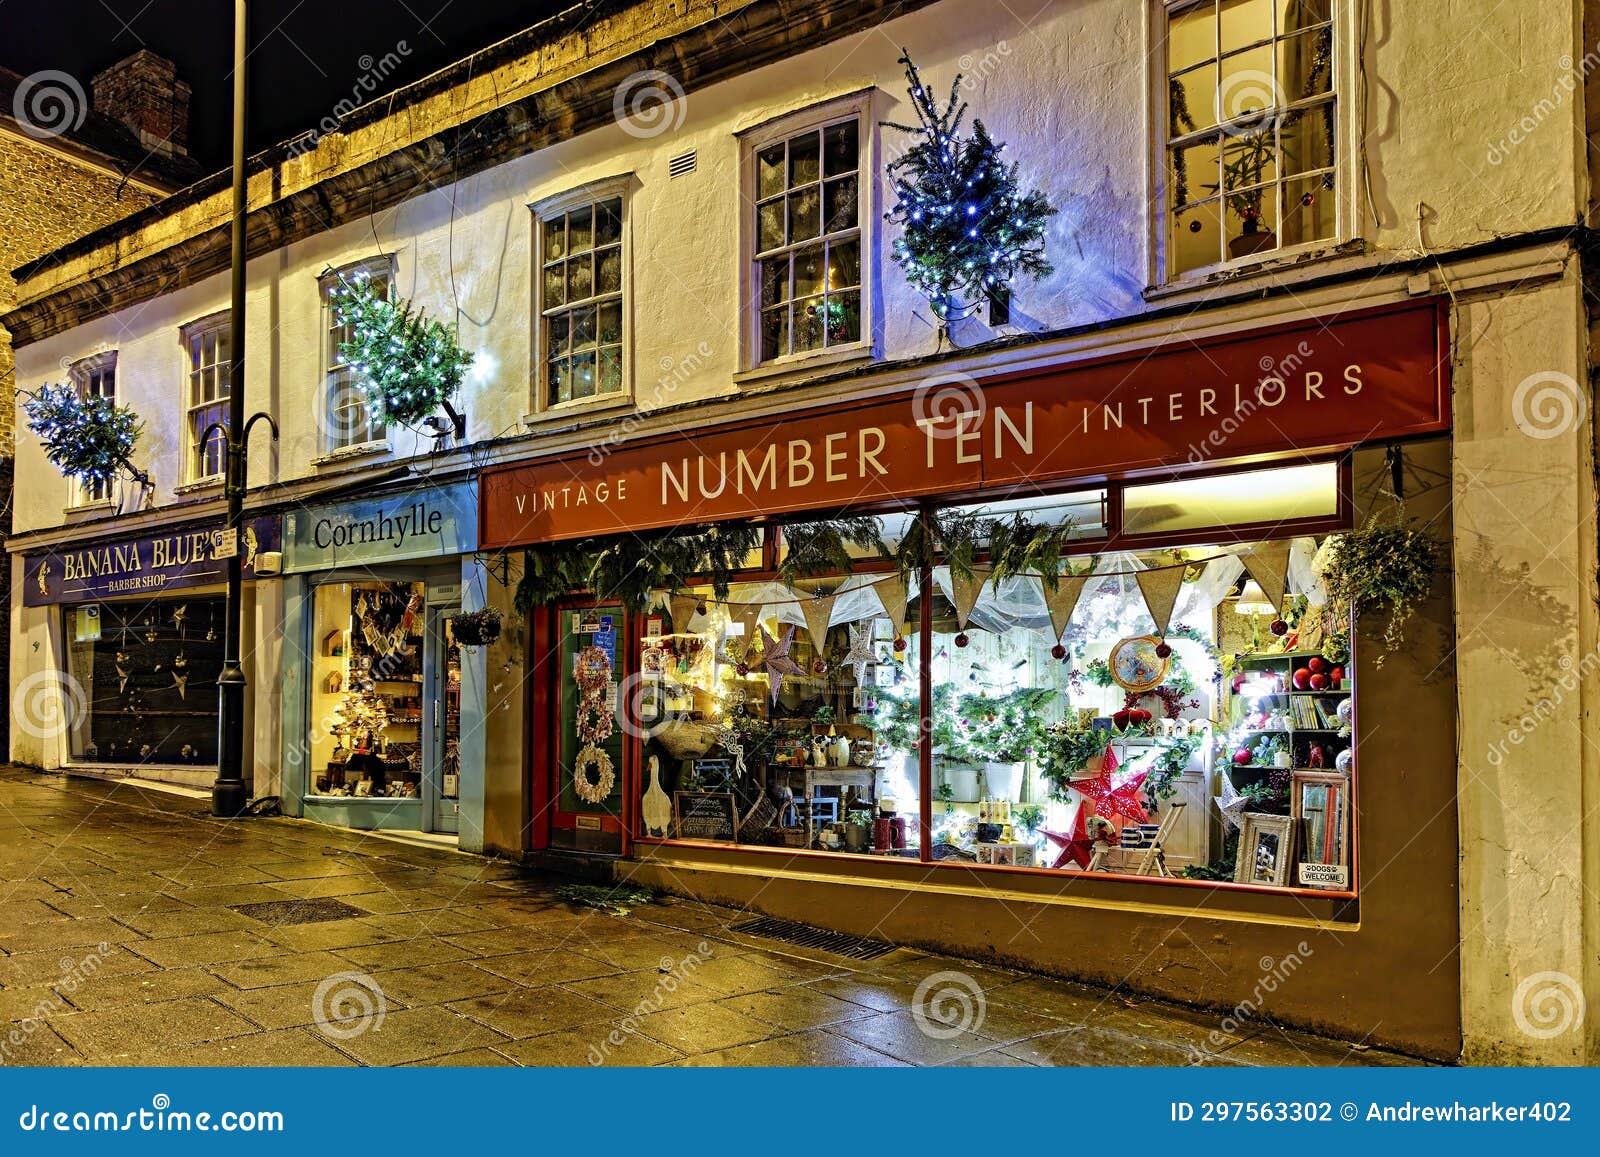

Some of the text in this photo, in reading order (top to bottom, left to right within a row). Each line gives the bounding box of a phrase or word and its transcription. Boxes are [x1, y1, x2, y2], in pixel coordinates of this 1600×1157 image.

[515, 364, 1363, 514] VINTAGE NUMBER TEN INTERIORS
[314, 502, 442, 548] Cornhylle
[63, 542, 142, 581] BANANA
[108, 573, 167, 592] BARBER SHOP
[1304, 873, 1340, 881] WELCOME
